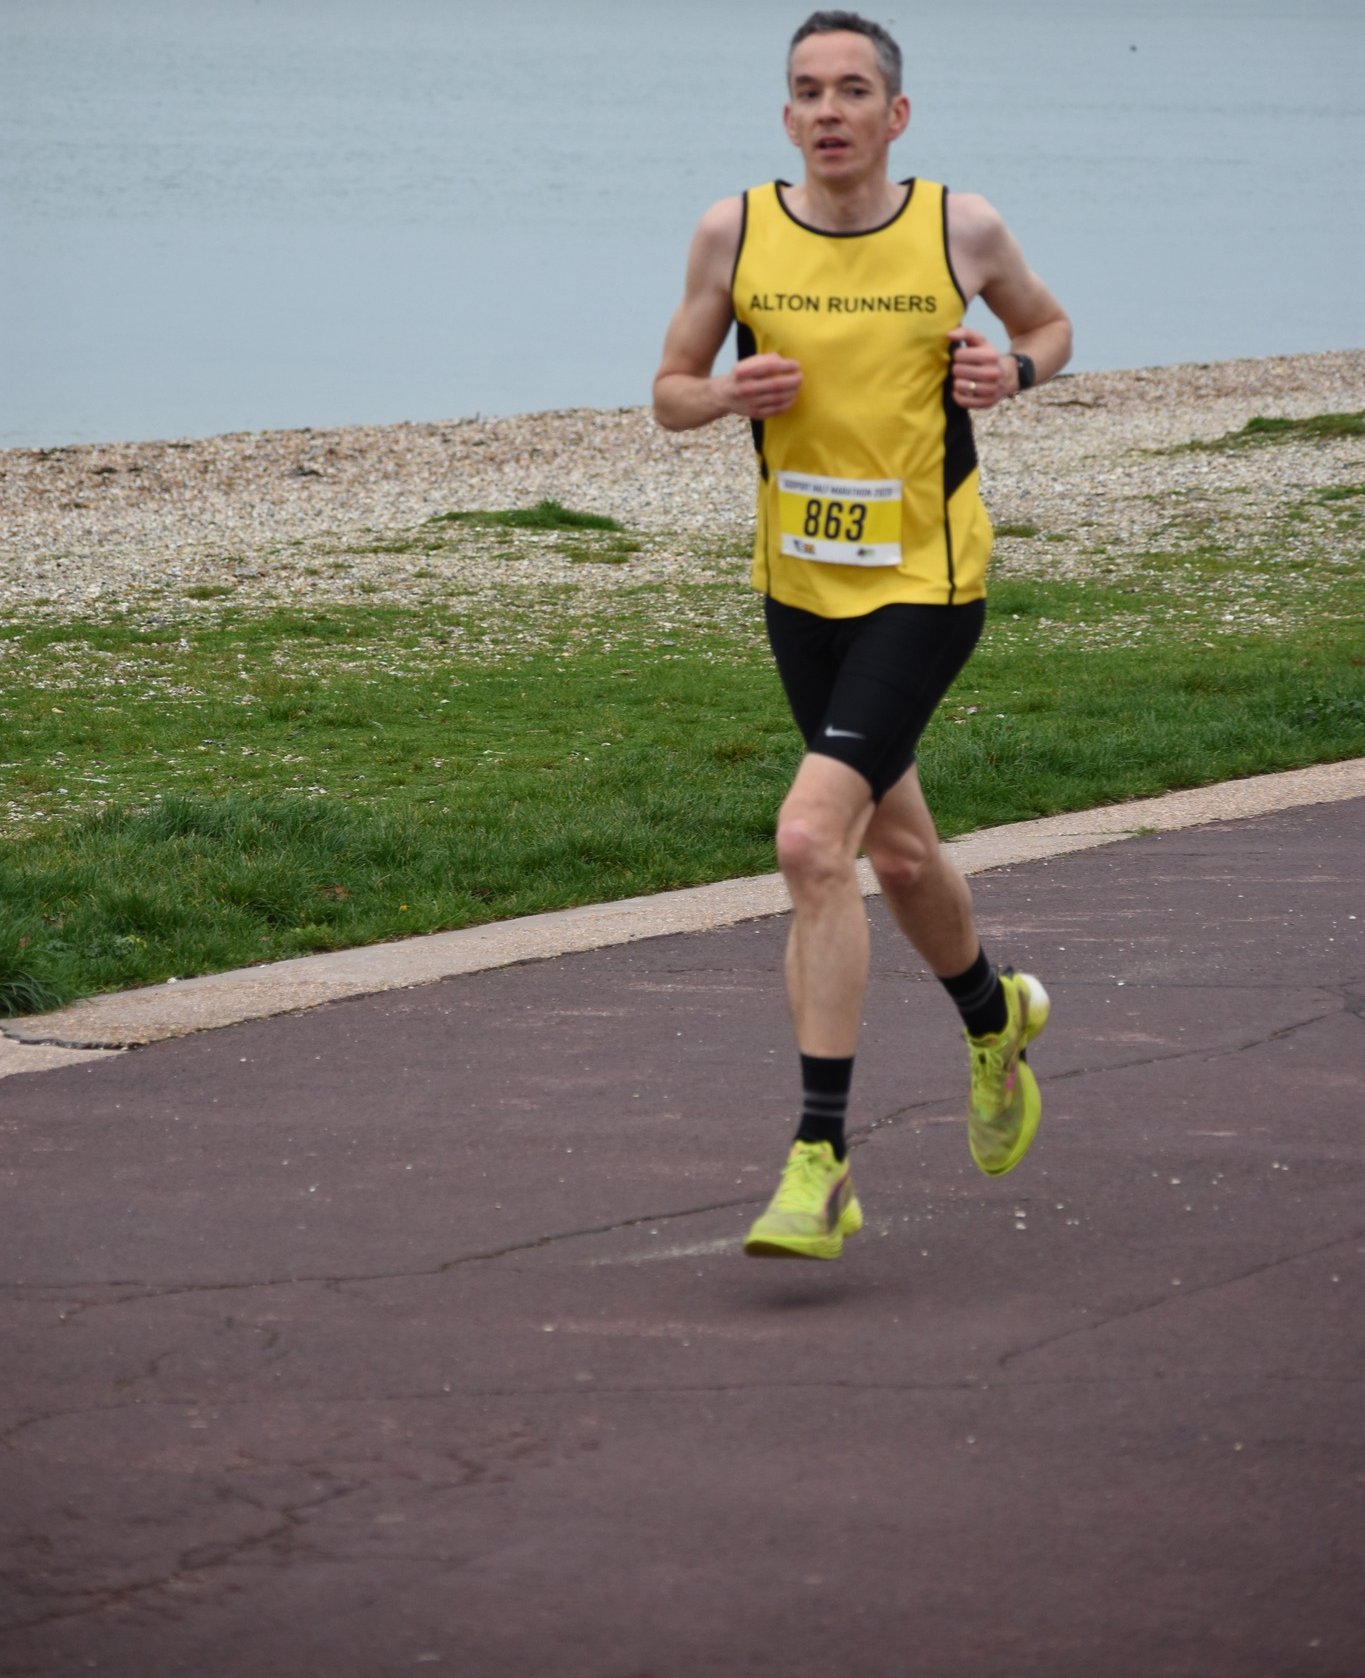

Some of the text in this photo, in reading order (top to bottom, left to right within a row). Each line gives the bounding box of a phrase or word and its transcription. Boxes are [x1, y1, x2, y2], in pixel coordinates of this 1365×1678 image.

[750, 293, 937, 313] ALTON RUNNERS
[804, 499, 867, 542] 863
